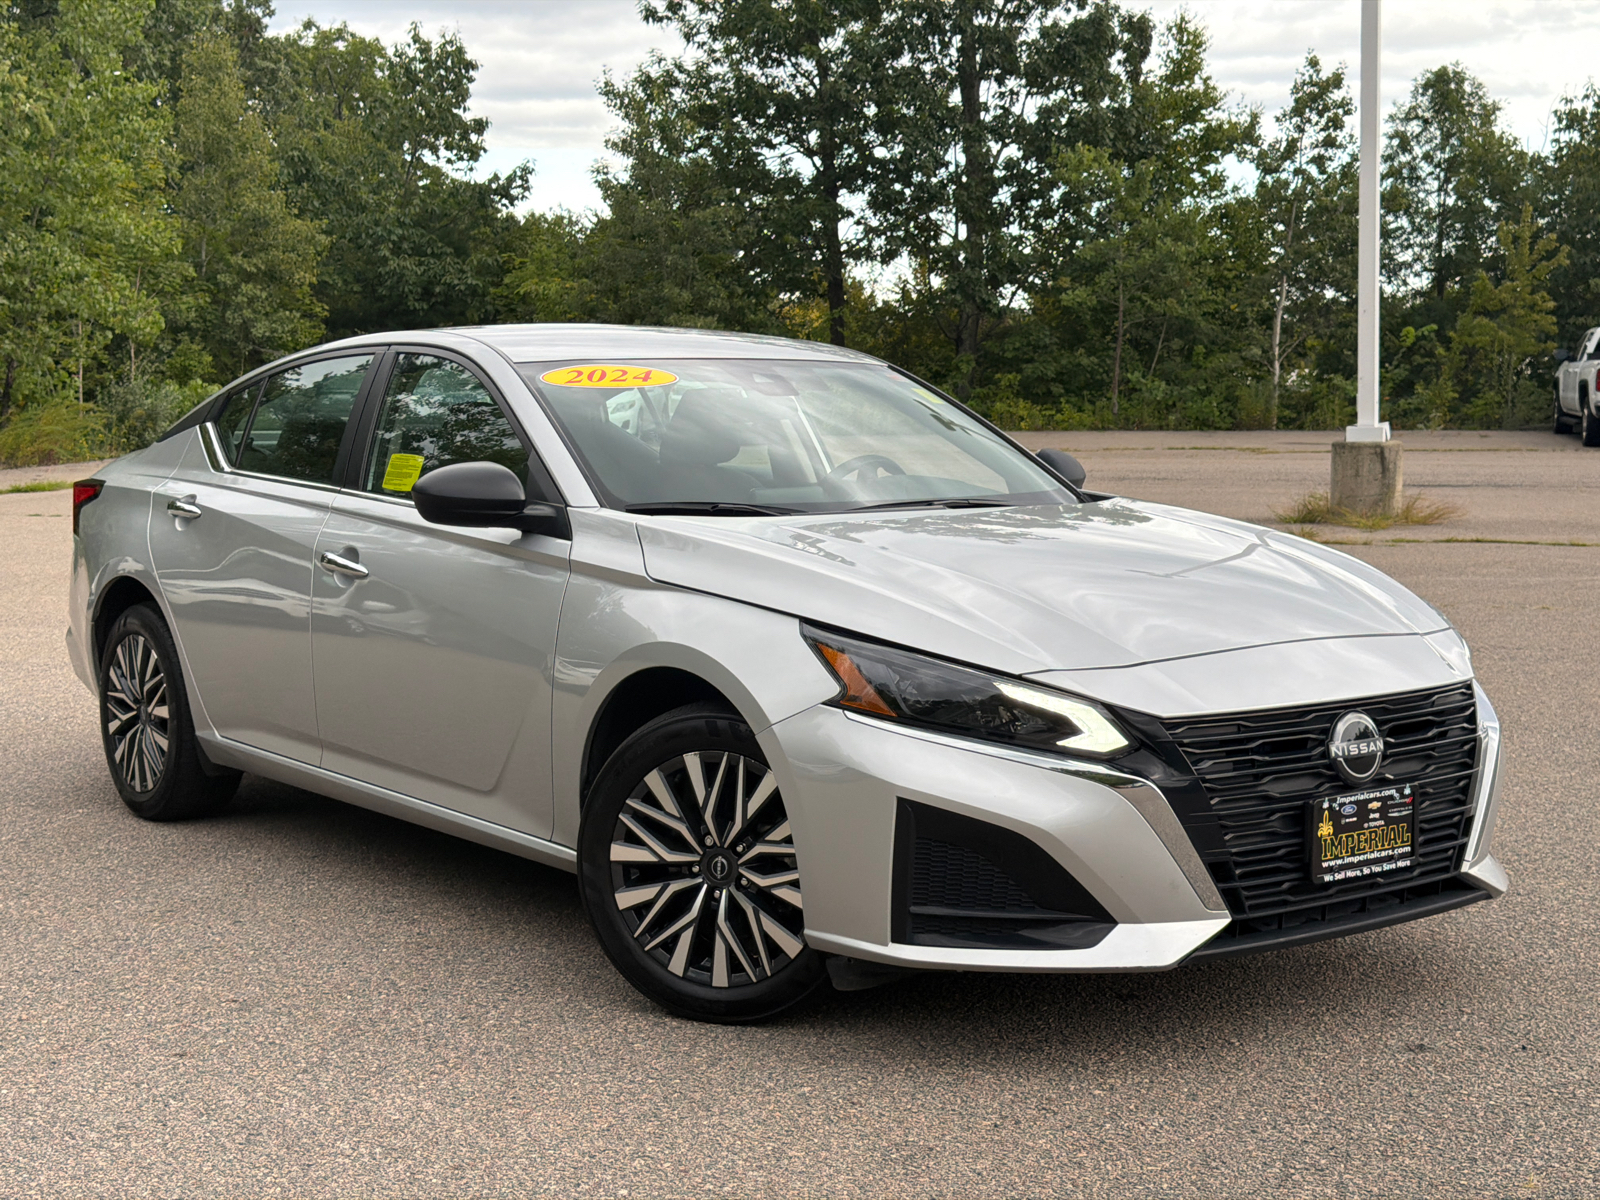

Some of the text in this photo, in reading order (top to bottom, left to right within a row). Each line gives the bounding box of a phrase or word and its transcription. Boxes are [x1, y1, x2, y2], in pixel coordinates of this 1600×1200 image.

[564, 369, 653, 384] 2024
[1331, 738, 1384, 757] NISSAN
[1336, 789, 1396, 804] Imperialcars.com
[1321, 823, 1411, 860] IMPERIAL
[1322, 846, 1411, 868] www.imperialcars.com
[1323, 874, 1333, 882] We
[1334, 871, 1345, 880] Sell
[1363, 867, 1371, 875] So
[1372, 864, 1382, 873] You
[1383, 862, 1396, 871] Save
[1397, 859, 1411, 869] More
